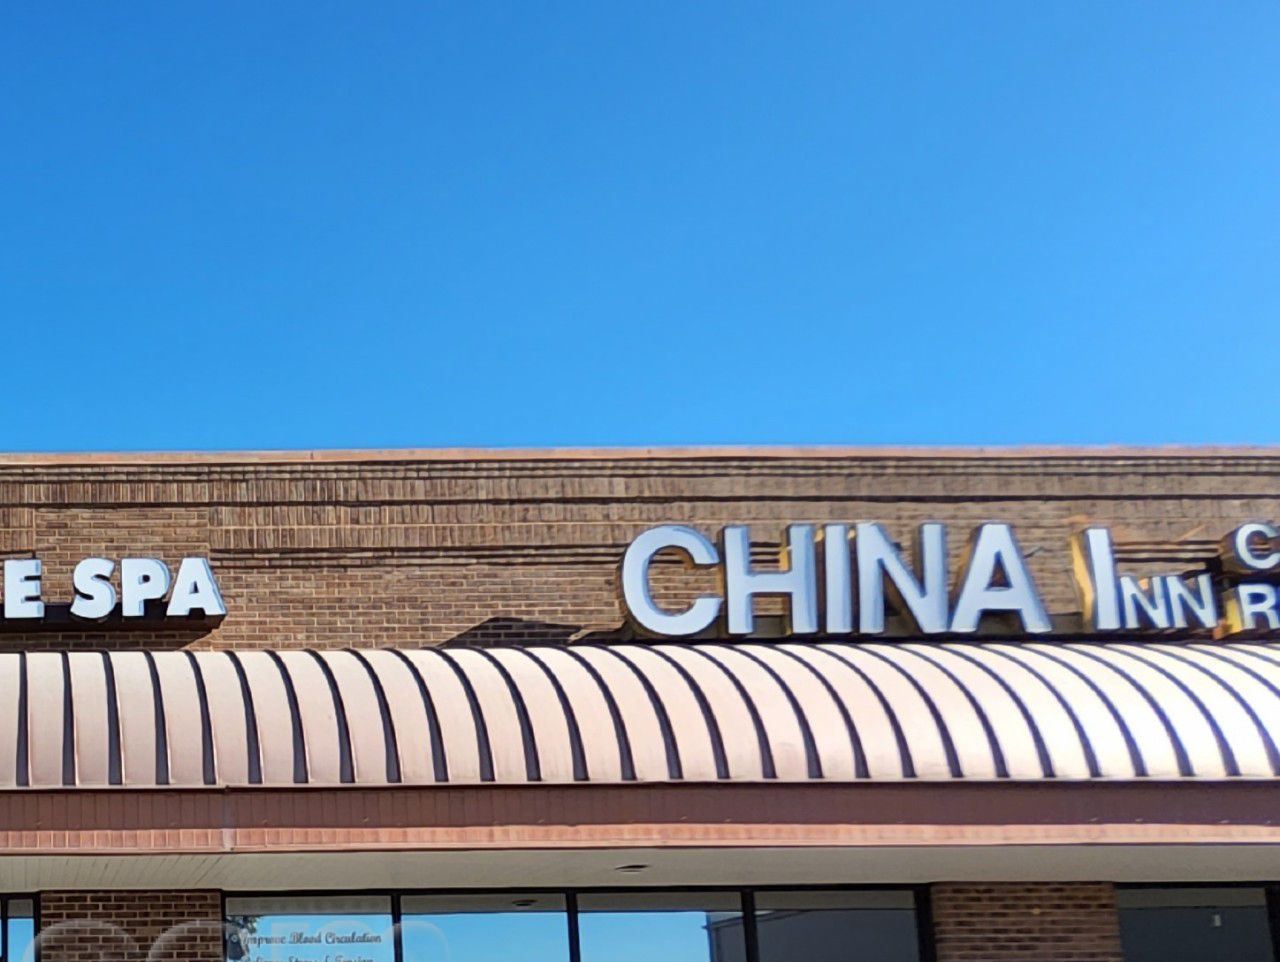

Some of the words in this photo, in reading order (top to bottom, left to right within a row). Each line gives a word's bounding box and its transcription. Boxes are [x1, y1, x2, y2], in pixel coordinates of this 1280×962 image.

[70, 557, 227, 619] SPA
[620, 522, 1052, 636] CHINA
[288, 931, 322, 944] Blood
[325, 931, 382, 945] Circulation
